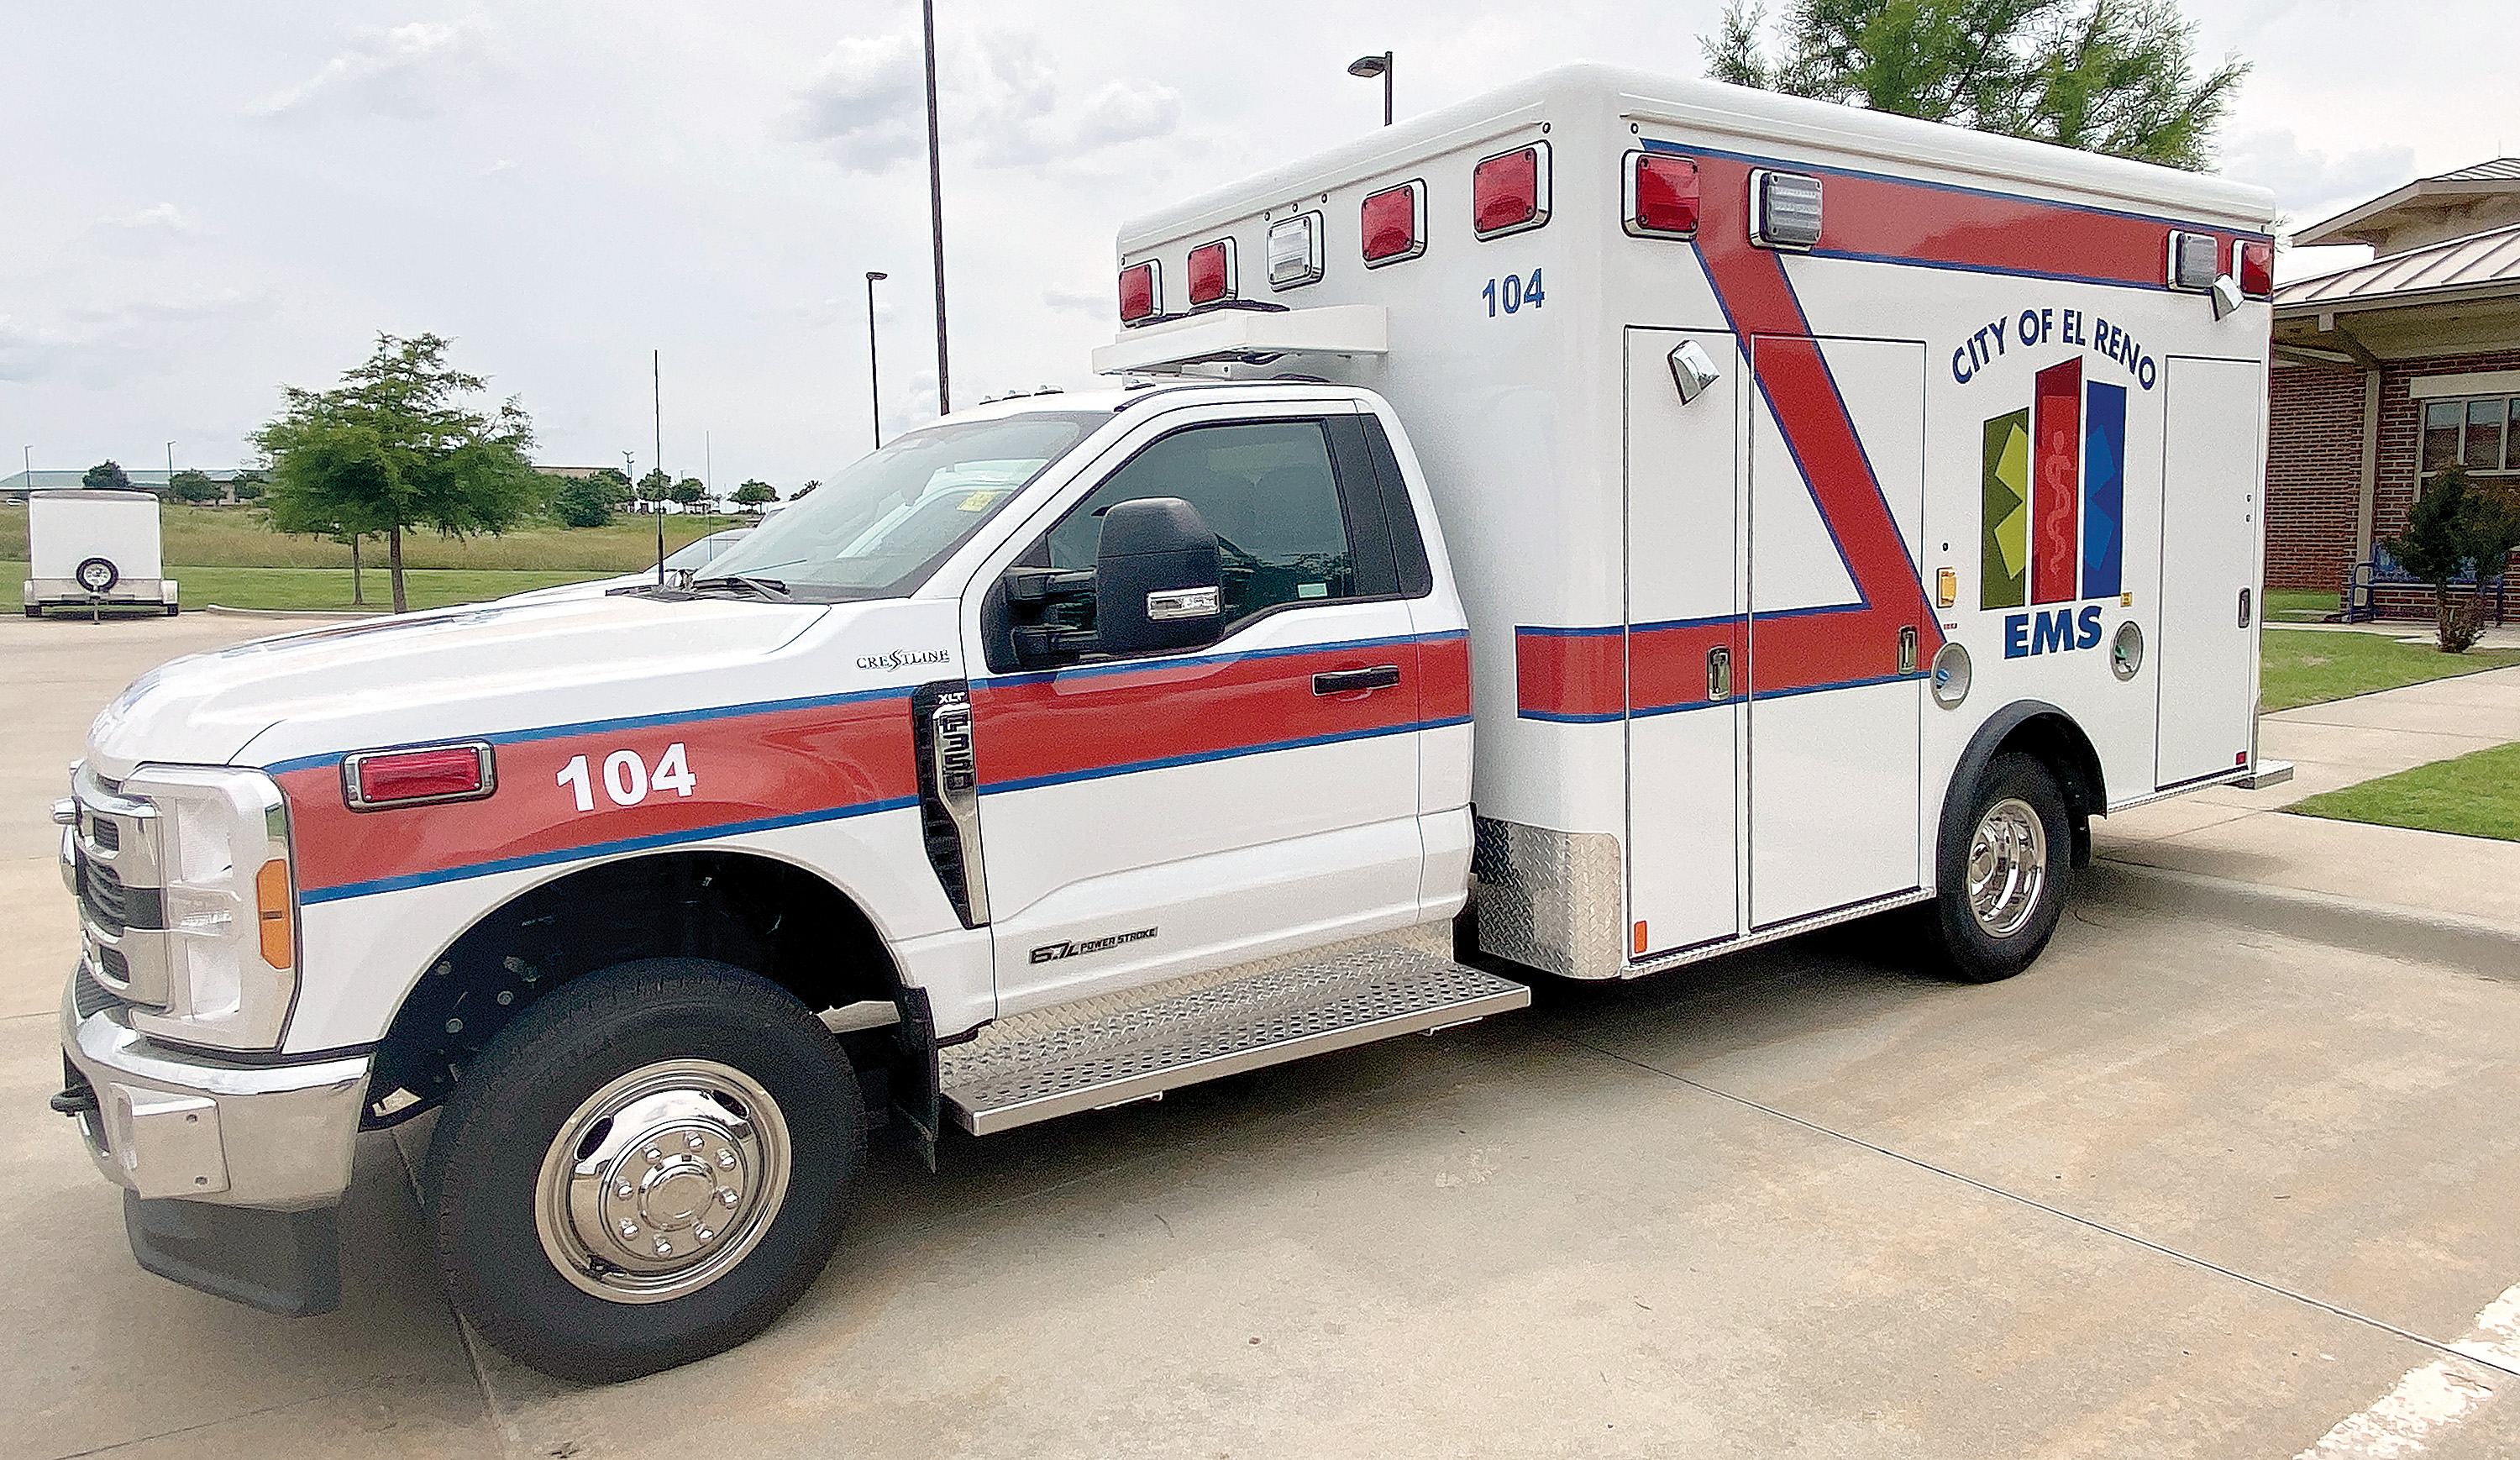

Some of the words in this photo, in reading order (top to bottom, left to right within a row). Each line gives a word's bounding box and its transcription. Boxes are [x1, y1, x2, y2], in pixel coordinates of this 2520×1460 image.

[1482, 268, 1546, 318] 104
[1951, 316, 2008, 385] CITY
[2019, 308, 2053, 347] OF
[2063, 308, 2087, 346] EL
[2093, 318, 2156, 391] RENO
[2004, 605, 2102, 660] EMS
[856, 648, 950, 671] CRESTLINE
[937, 691, 966, 704] XLT
[556, 742, 698, 812] 104
[1030, 941, 1079, 964] 6.7L
[1080, 936, 1116, 953] POWER
[1117, 927, 1157, 944] STROKE
